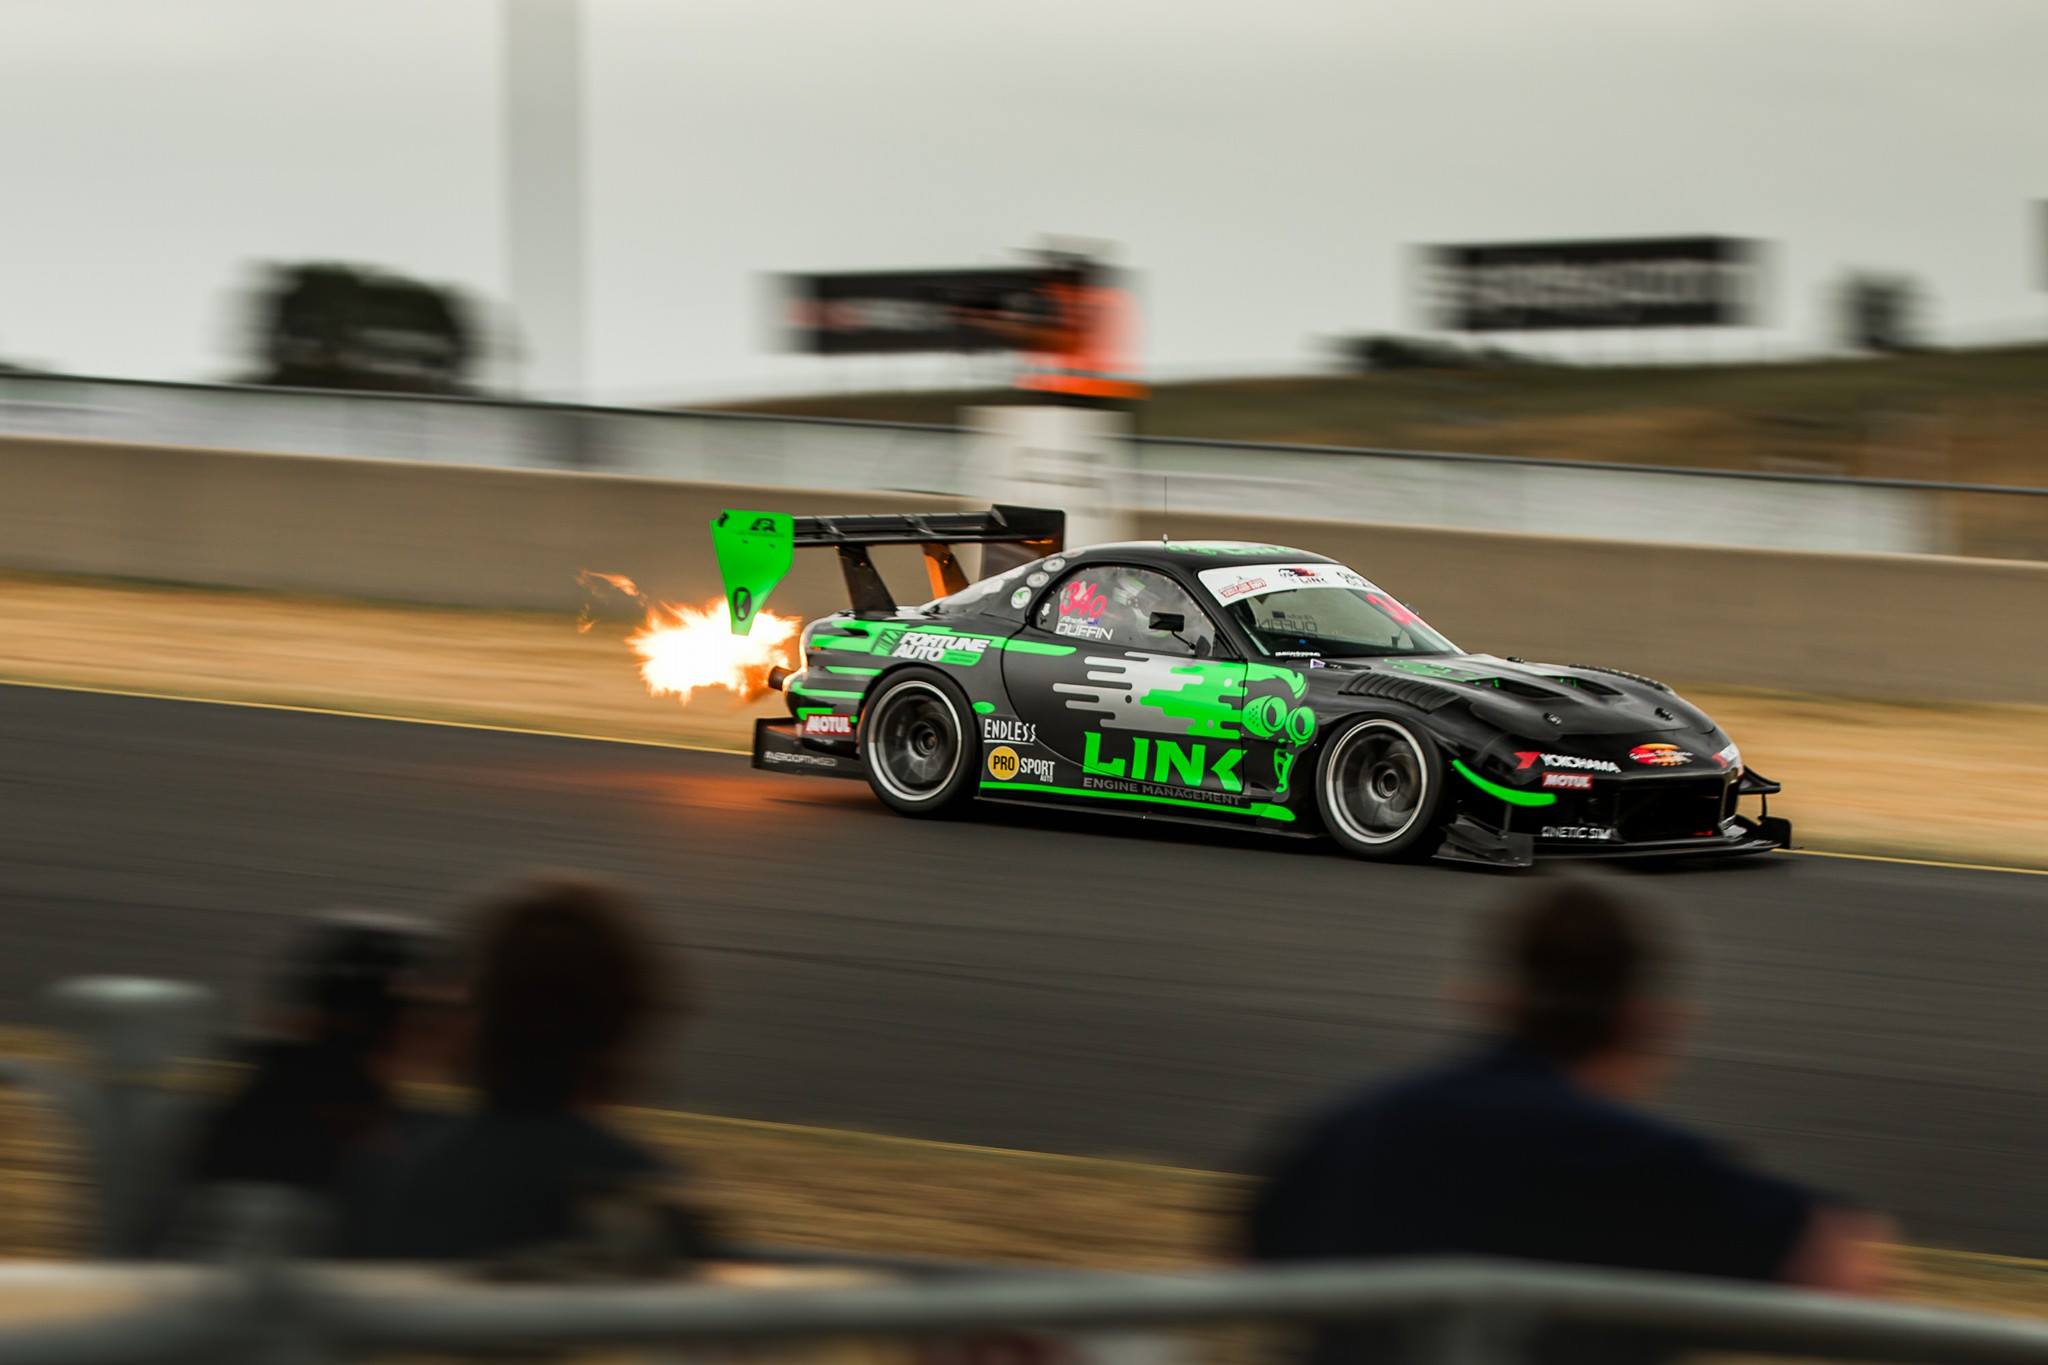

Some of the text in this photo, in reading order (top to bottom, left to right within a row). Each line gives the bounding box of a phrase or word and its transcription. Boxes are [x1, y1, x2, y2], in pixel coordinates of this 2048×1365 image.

[1059, 580, 1108, 618] 340
[1055, 622, 1113, 640] DUFFIN
[899, 631, 990, 653] FORTUNE
[892, 644, 945, 662] AUTO
[805, 715, 851, 733] MOTUL
[984, 718, 1037, 742] ENDLESS
[993, 755, 1055, 775] PRO SPORT
[1082, 731, 1249, 793] LINK
[1539, 753, 1621, 773] YOKOHAMA
[1543, 774, 1592, 788] MOTUL
[1083, 777, 1241, 806] ENGINE MANAGEMENT
